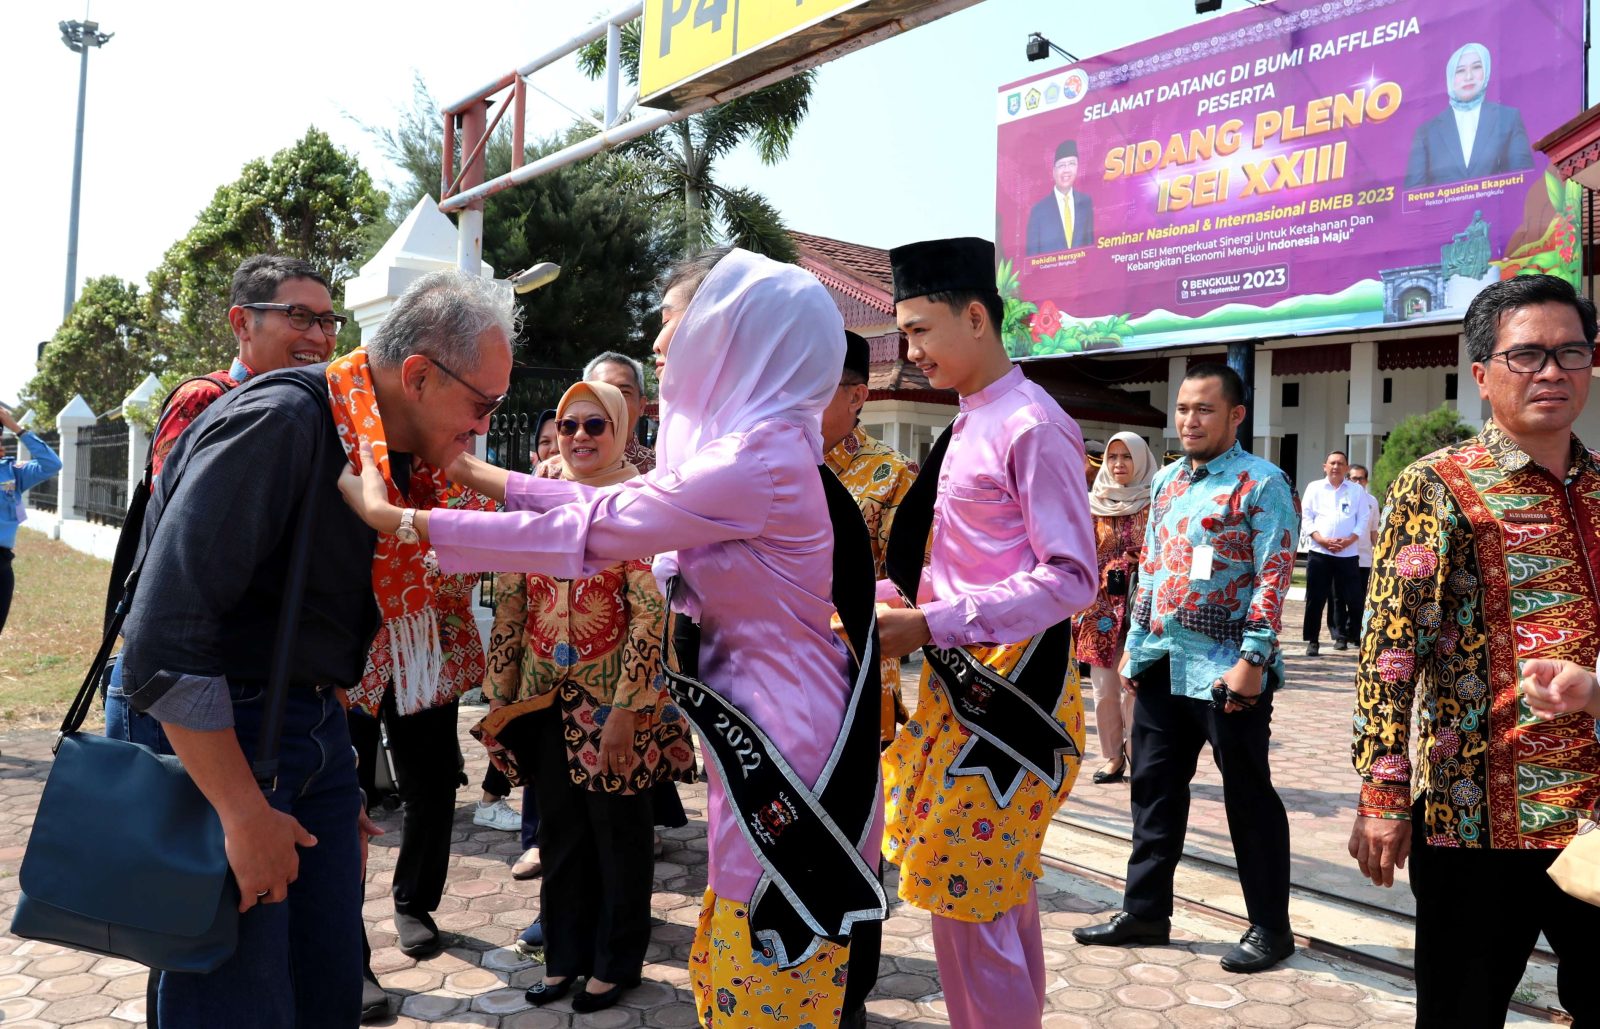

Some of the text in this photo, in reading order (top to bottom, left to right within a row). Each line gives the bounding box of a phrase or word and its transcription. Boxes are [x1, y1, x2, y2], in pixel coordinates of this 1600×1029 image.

[1083, 16, 1421, 122] SELAMAT DATANG DI BUMI RAFFLESIA
[1197, 82, 1276, 116] PESERTA
[1103, 81, 1403, 181] SIDANG PLENO
[1156, 140, 1348, 214] ISEI XXIII
[1408, 174, 1524, 202] Retno Agustina Ekaputri
[1097, 186, 1395, 249] Seminar Nasional & Internasional BMEB 2023
[1141, 248, 1157, 259] ISEI
[1159, 239, 1218, 257] Memperkuat
[1219, 232, 1254, 248] Sinergi
[1256, 227, 1287, 241] Untuk
[1289, 218, 1348, 236] Ketahanan
[1350, 215, 1374, 227] Dan
[1127, 228, 1355, 273] Kebangkitan Ekonomi Menuju Indonesia Maju"
[1190, 267, 1286, 290] BENGKULU 2023
[1208, 285, 1241, 295] September
[713, 712, 762, 780] 2022
